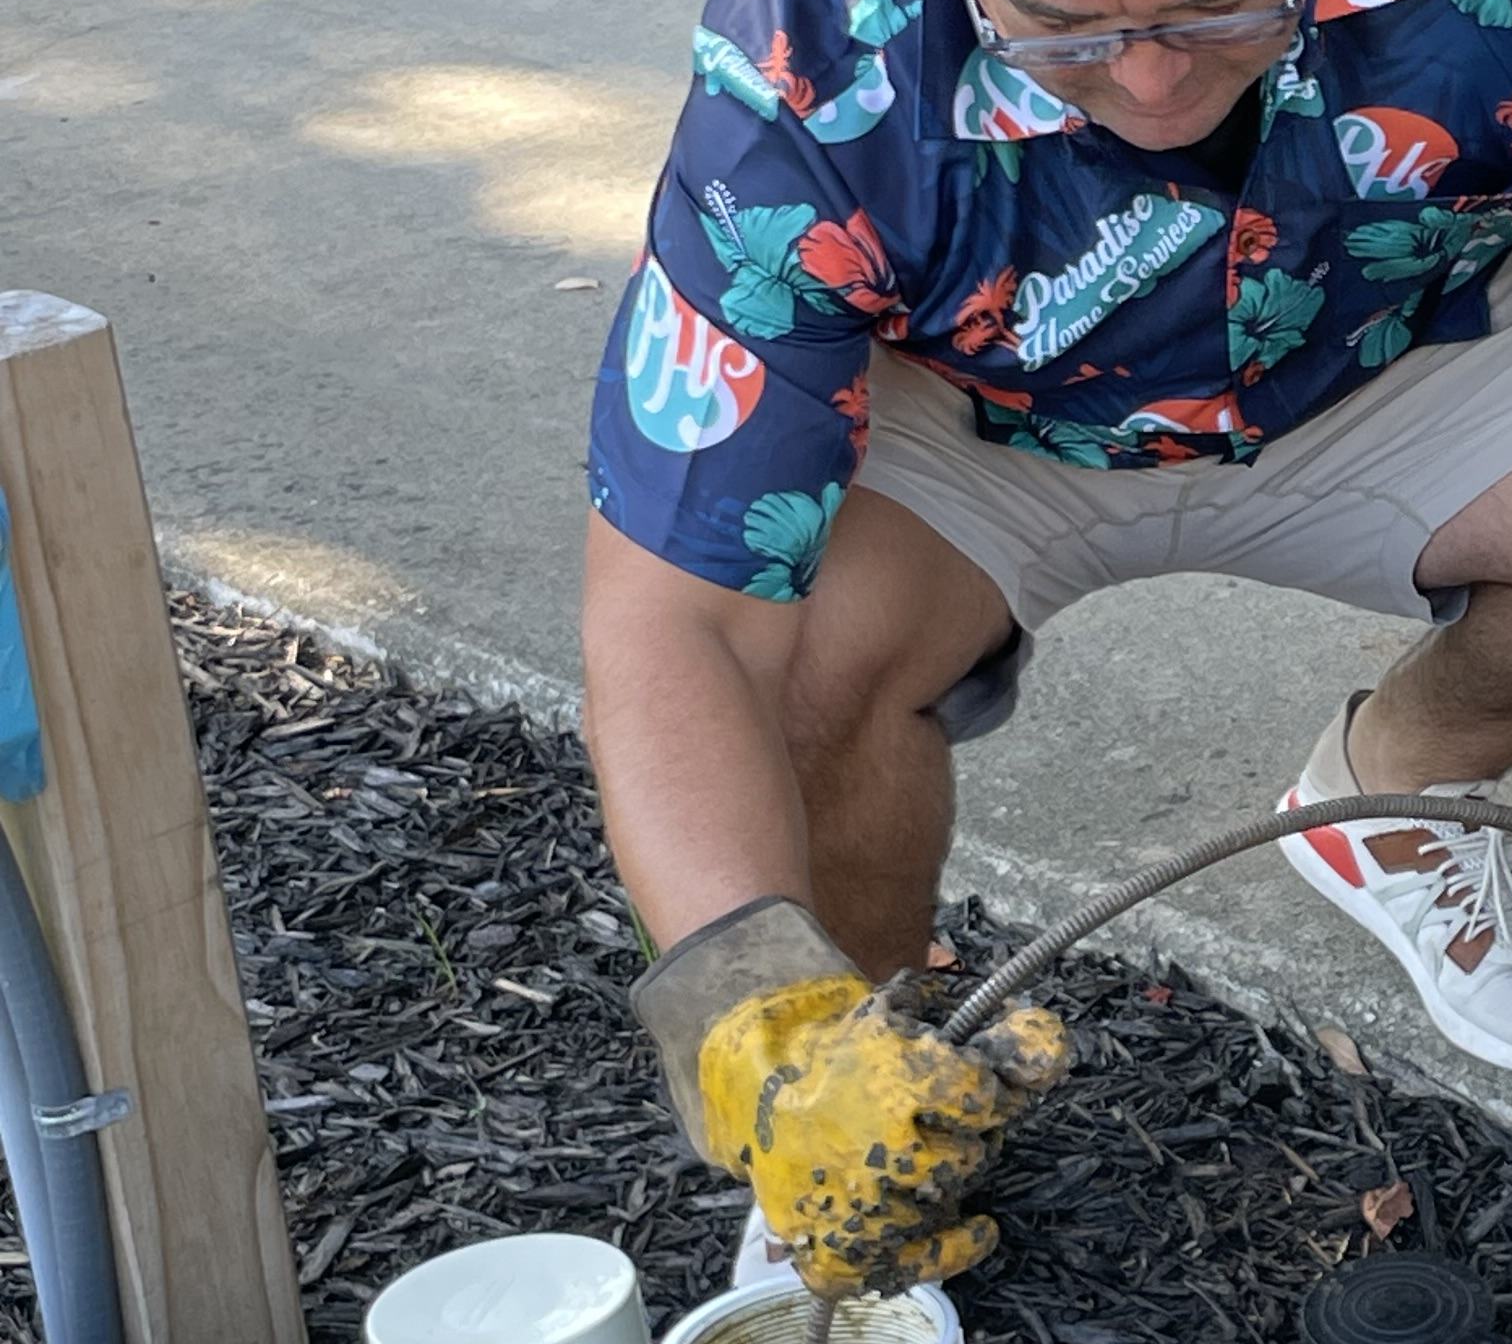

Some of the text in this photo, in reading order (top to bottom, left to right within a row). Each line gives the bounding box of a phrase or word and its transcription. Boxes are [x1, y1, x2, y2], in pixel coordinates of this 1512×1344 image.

[1013, 193, 1153, 335] Paradise
[1017, 201, 1202, 372] Home Services
[627, 254, 760, 451] PHS
